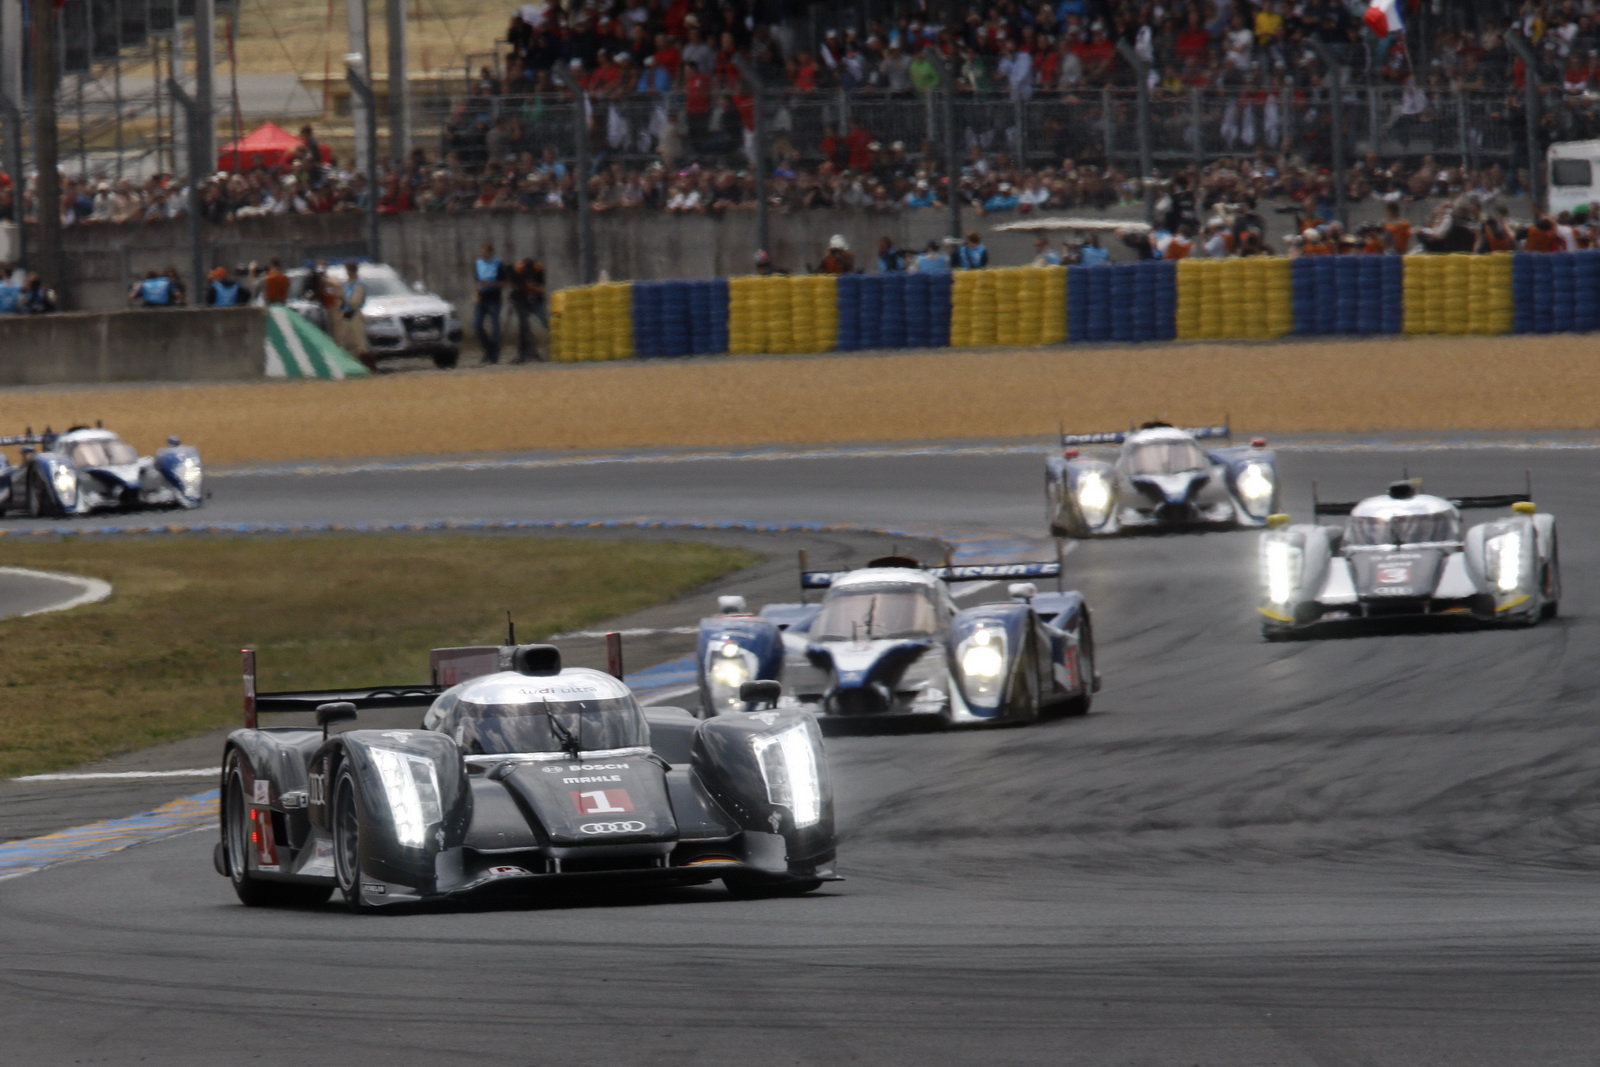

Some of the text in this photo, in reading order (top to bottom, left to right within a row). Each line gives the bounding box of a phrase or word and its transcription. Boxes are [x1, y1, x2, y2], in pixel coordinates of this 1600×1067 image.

[1381, 568, 1407, 583] 3
[519, 686, 598, 695] Audi ultra
[568, 763, 630, 772] BOSCH
[562, 774, 622, 784] MAHLE
[580, 790, 626, 814] 1
[258, 812, 274, 864] 1
